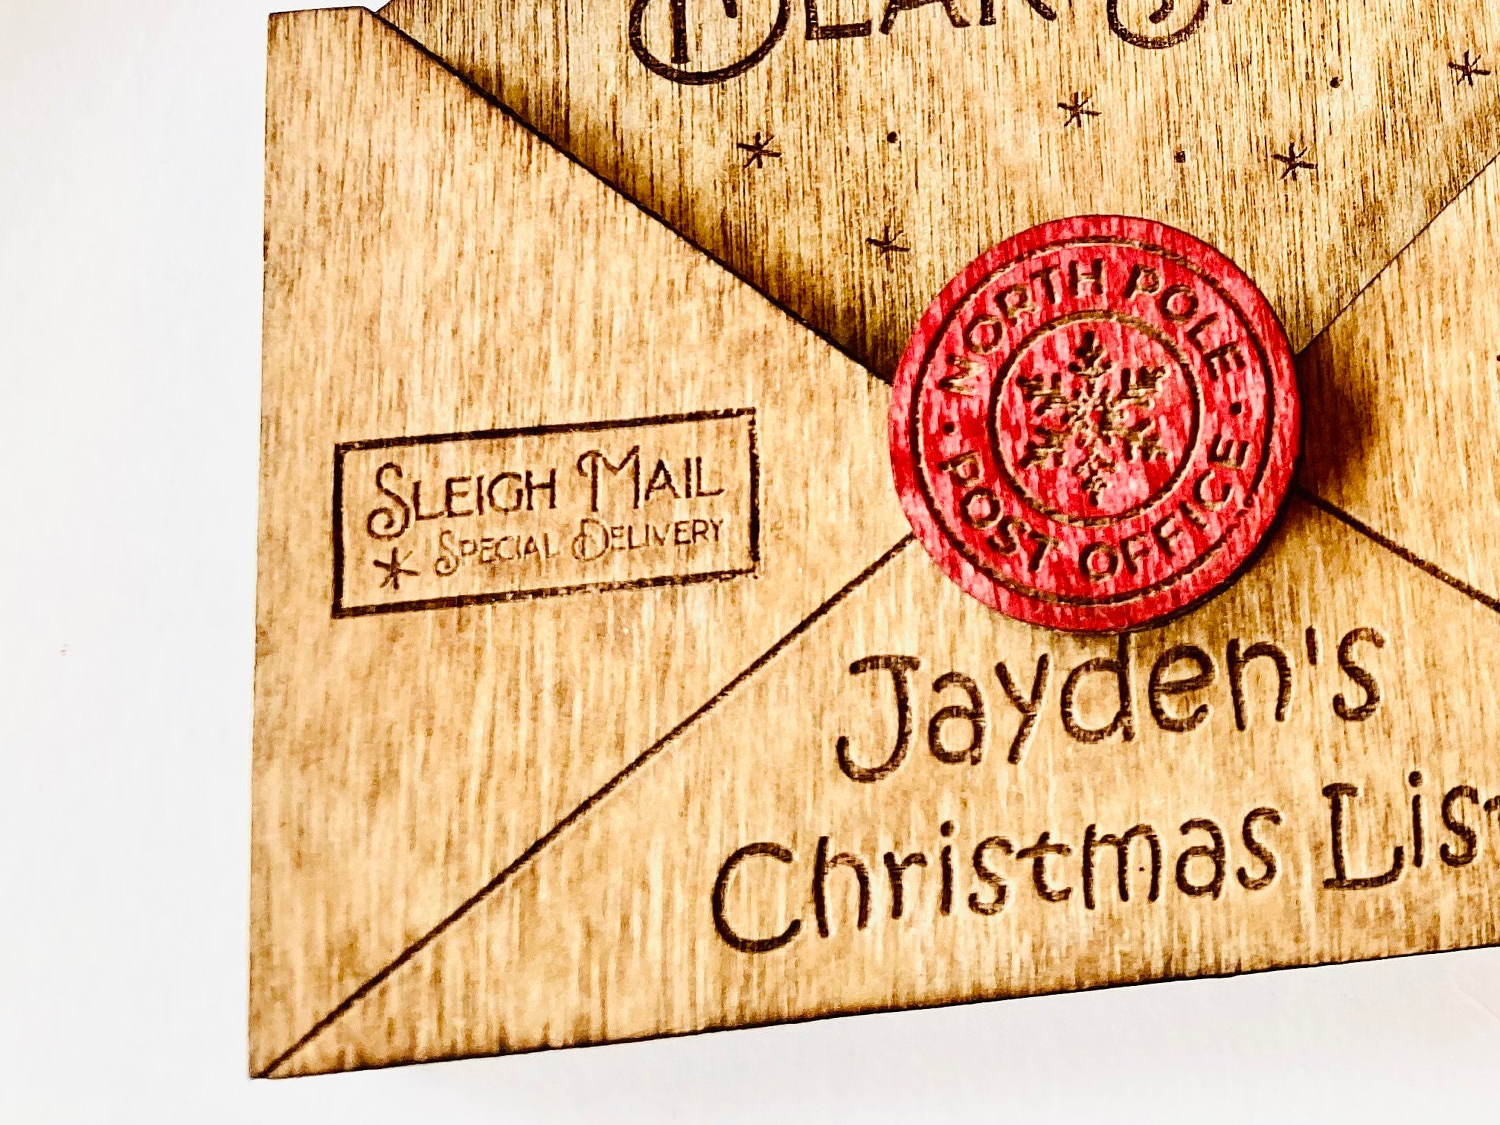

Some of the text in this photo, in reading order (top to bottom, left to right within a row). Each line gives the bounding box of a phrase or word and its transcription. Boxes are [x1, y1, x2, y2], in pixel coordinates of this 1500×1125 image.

[939, 258, 1246, 398] NORTH POLE
[367, 445, 725, 539] SLEIGH MAIL
[939, 435, 1250, 581] POST OFFICE
[837, 627, 1386, 783] Jayden's
[711, 807, 1285, 954] Christmas
